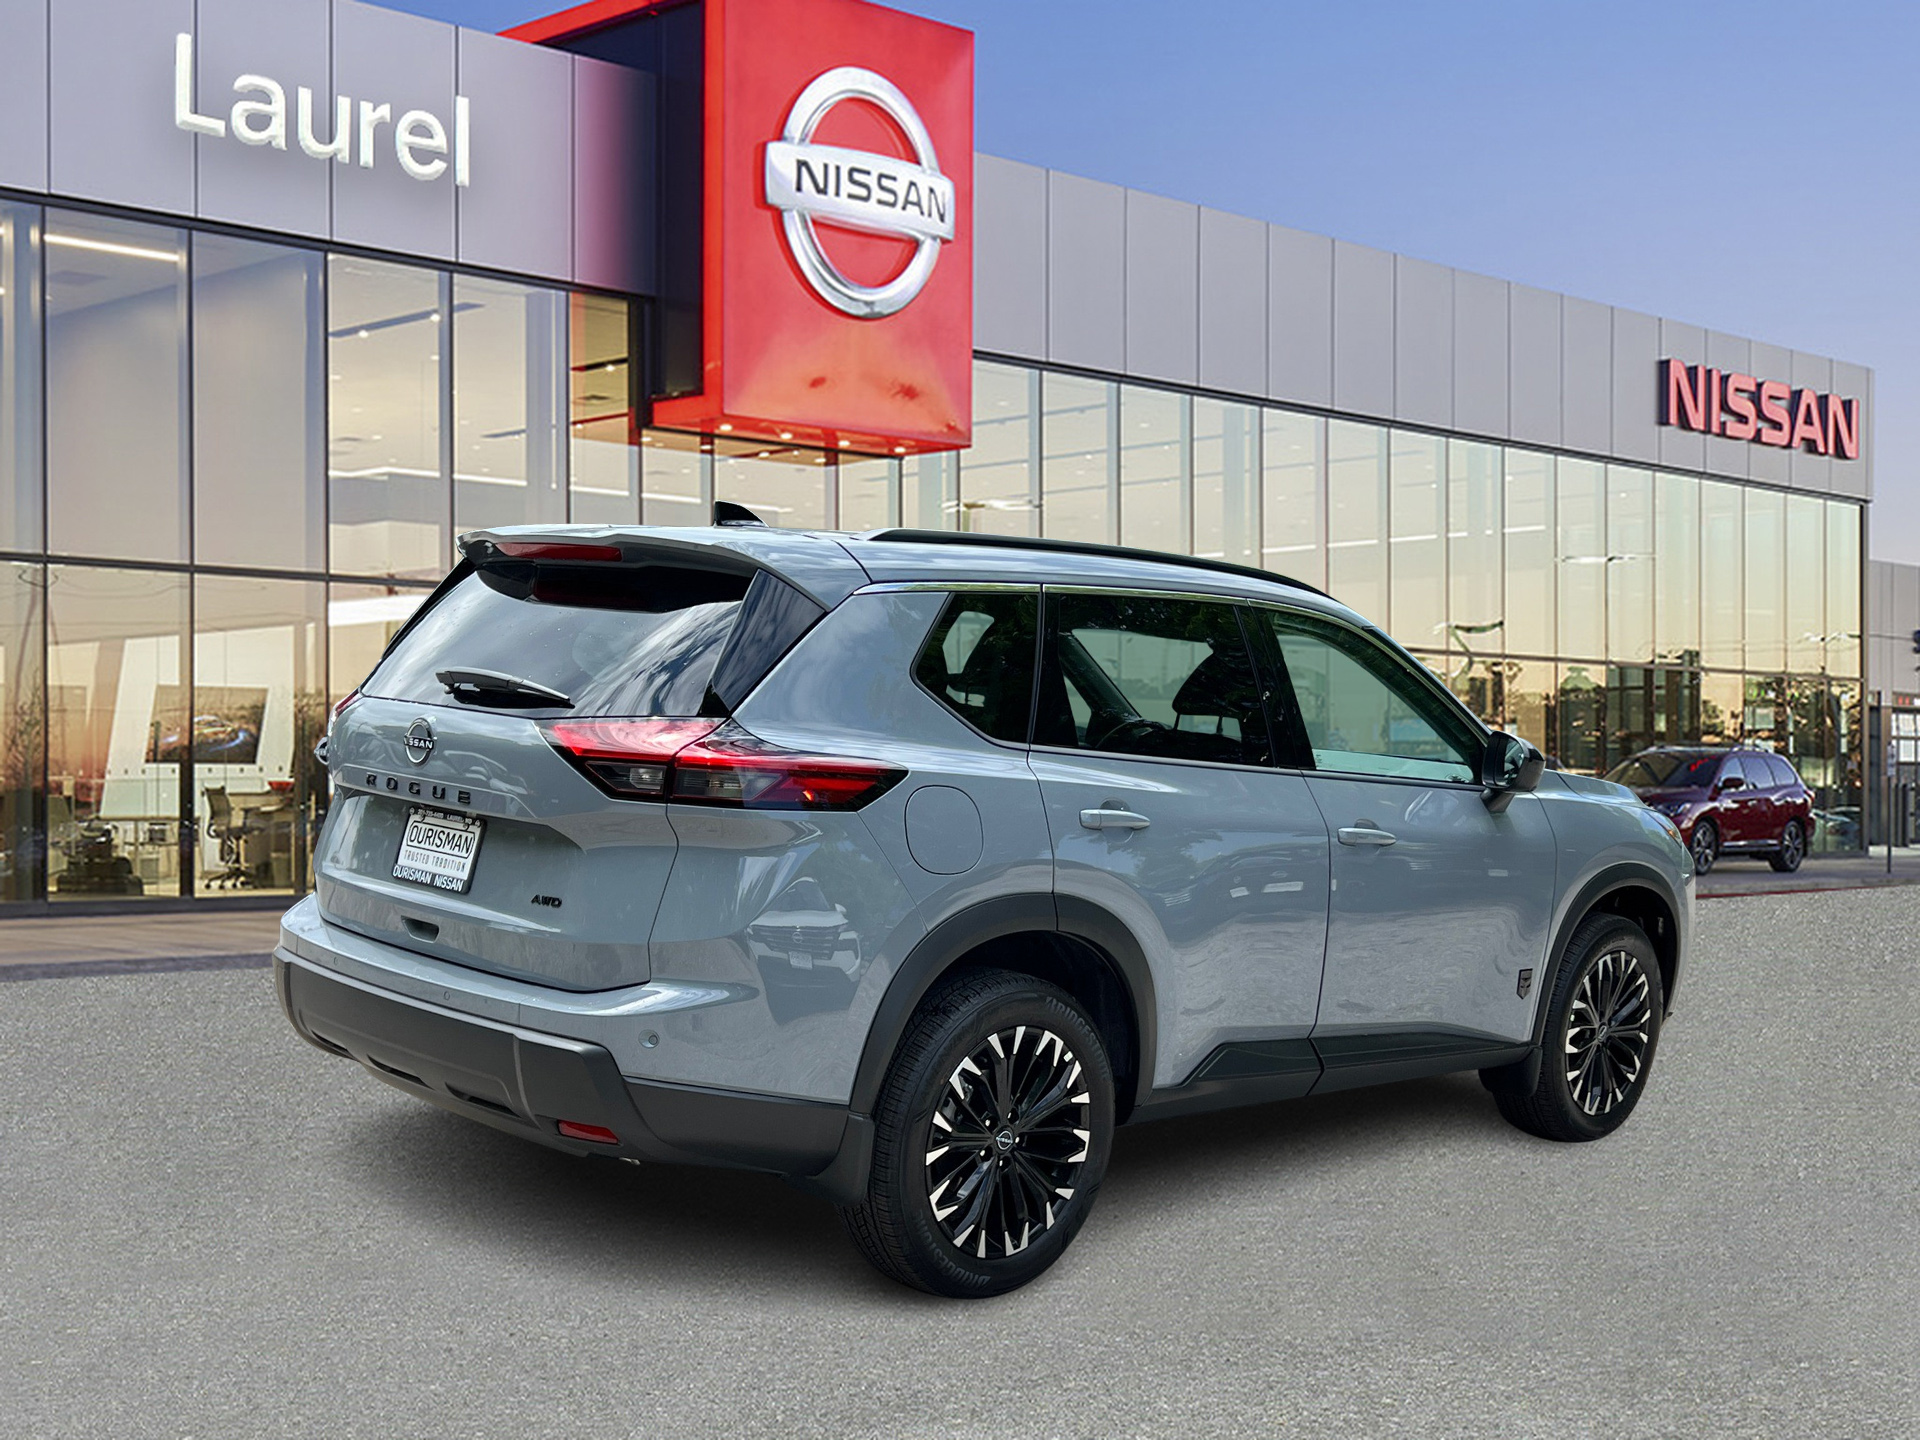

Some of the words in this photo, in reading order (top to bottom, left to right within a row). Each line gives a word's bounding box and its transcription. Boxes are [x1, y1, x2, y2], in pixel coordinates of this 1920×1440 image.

[175, 32, 470, 187] Laurel
[795, 158, 947, 224] NISSAN
[1657, 357, 1860, 460] NISSAN
[366, 772, 471, 805] ROGUE
[409, 825, 473, 854] OURISMAN
[404, 849, 430, 865] TRUSTED
[431, 856, 467, 873] TRADITION
[392, 865, 433, 885] OURISMAN
[433, 874, 464, 892] NISSAN
[531, 894, 563, 909] AWD
